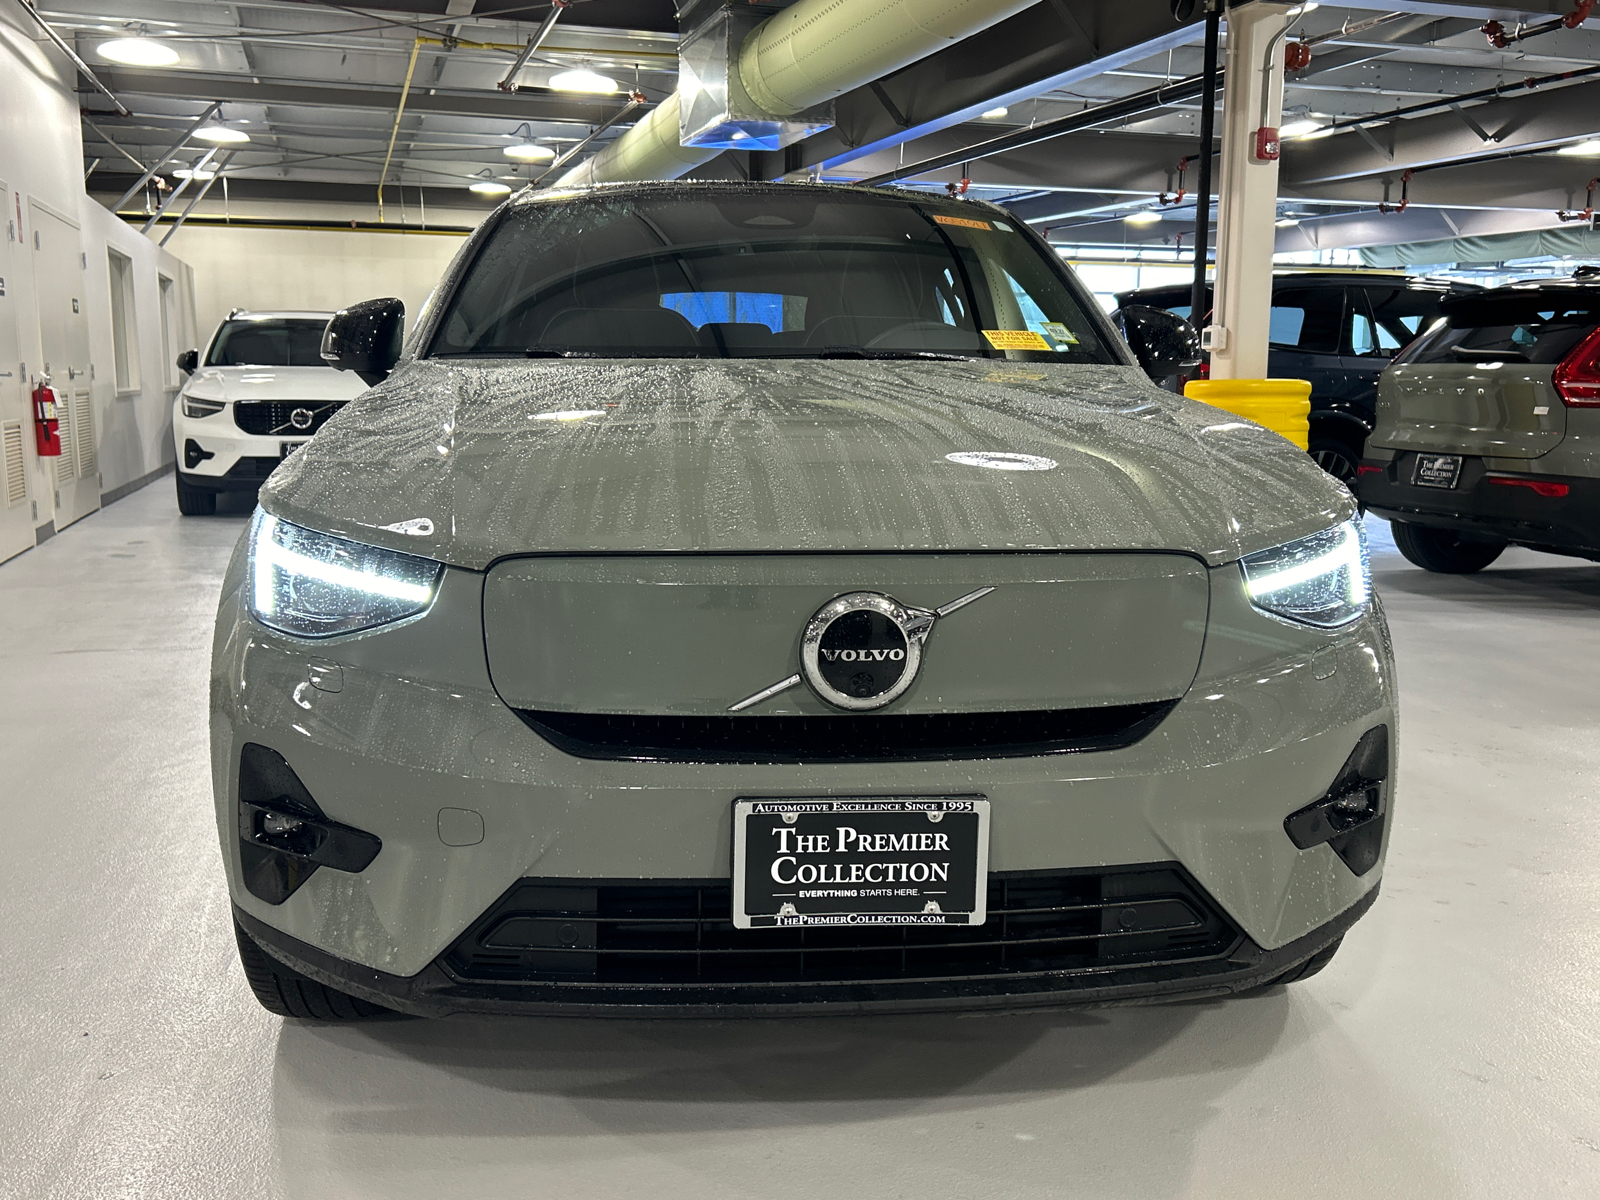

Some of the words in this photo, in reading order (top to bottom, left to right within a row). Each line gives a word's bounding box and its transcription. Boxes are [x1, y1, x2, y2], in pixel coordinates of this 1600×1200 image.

[1420, 467, 1452, 478] COLLECTION
[820, 648, 905, 662] VOLVO
[754, 803, 829, 813] AUTOMOTIVE
[832, 802, 902, 812] EXCELLENCE
[904, 801, 939, 811] SINCE
[941, 801, 973, 811] 1995
[771, 827, 831, 854] THE
[835, 826, 951, 853] PREMIER
[770, 855, 951, 885] COLLECTION
[798, 889, 858, 898] EVERYTHING
[859, 888, 893, 897] STARTS
[894, 888, 921, 896] HERE.
